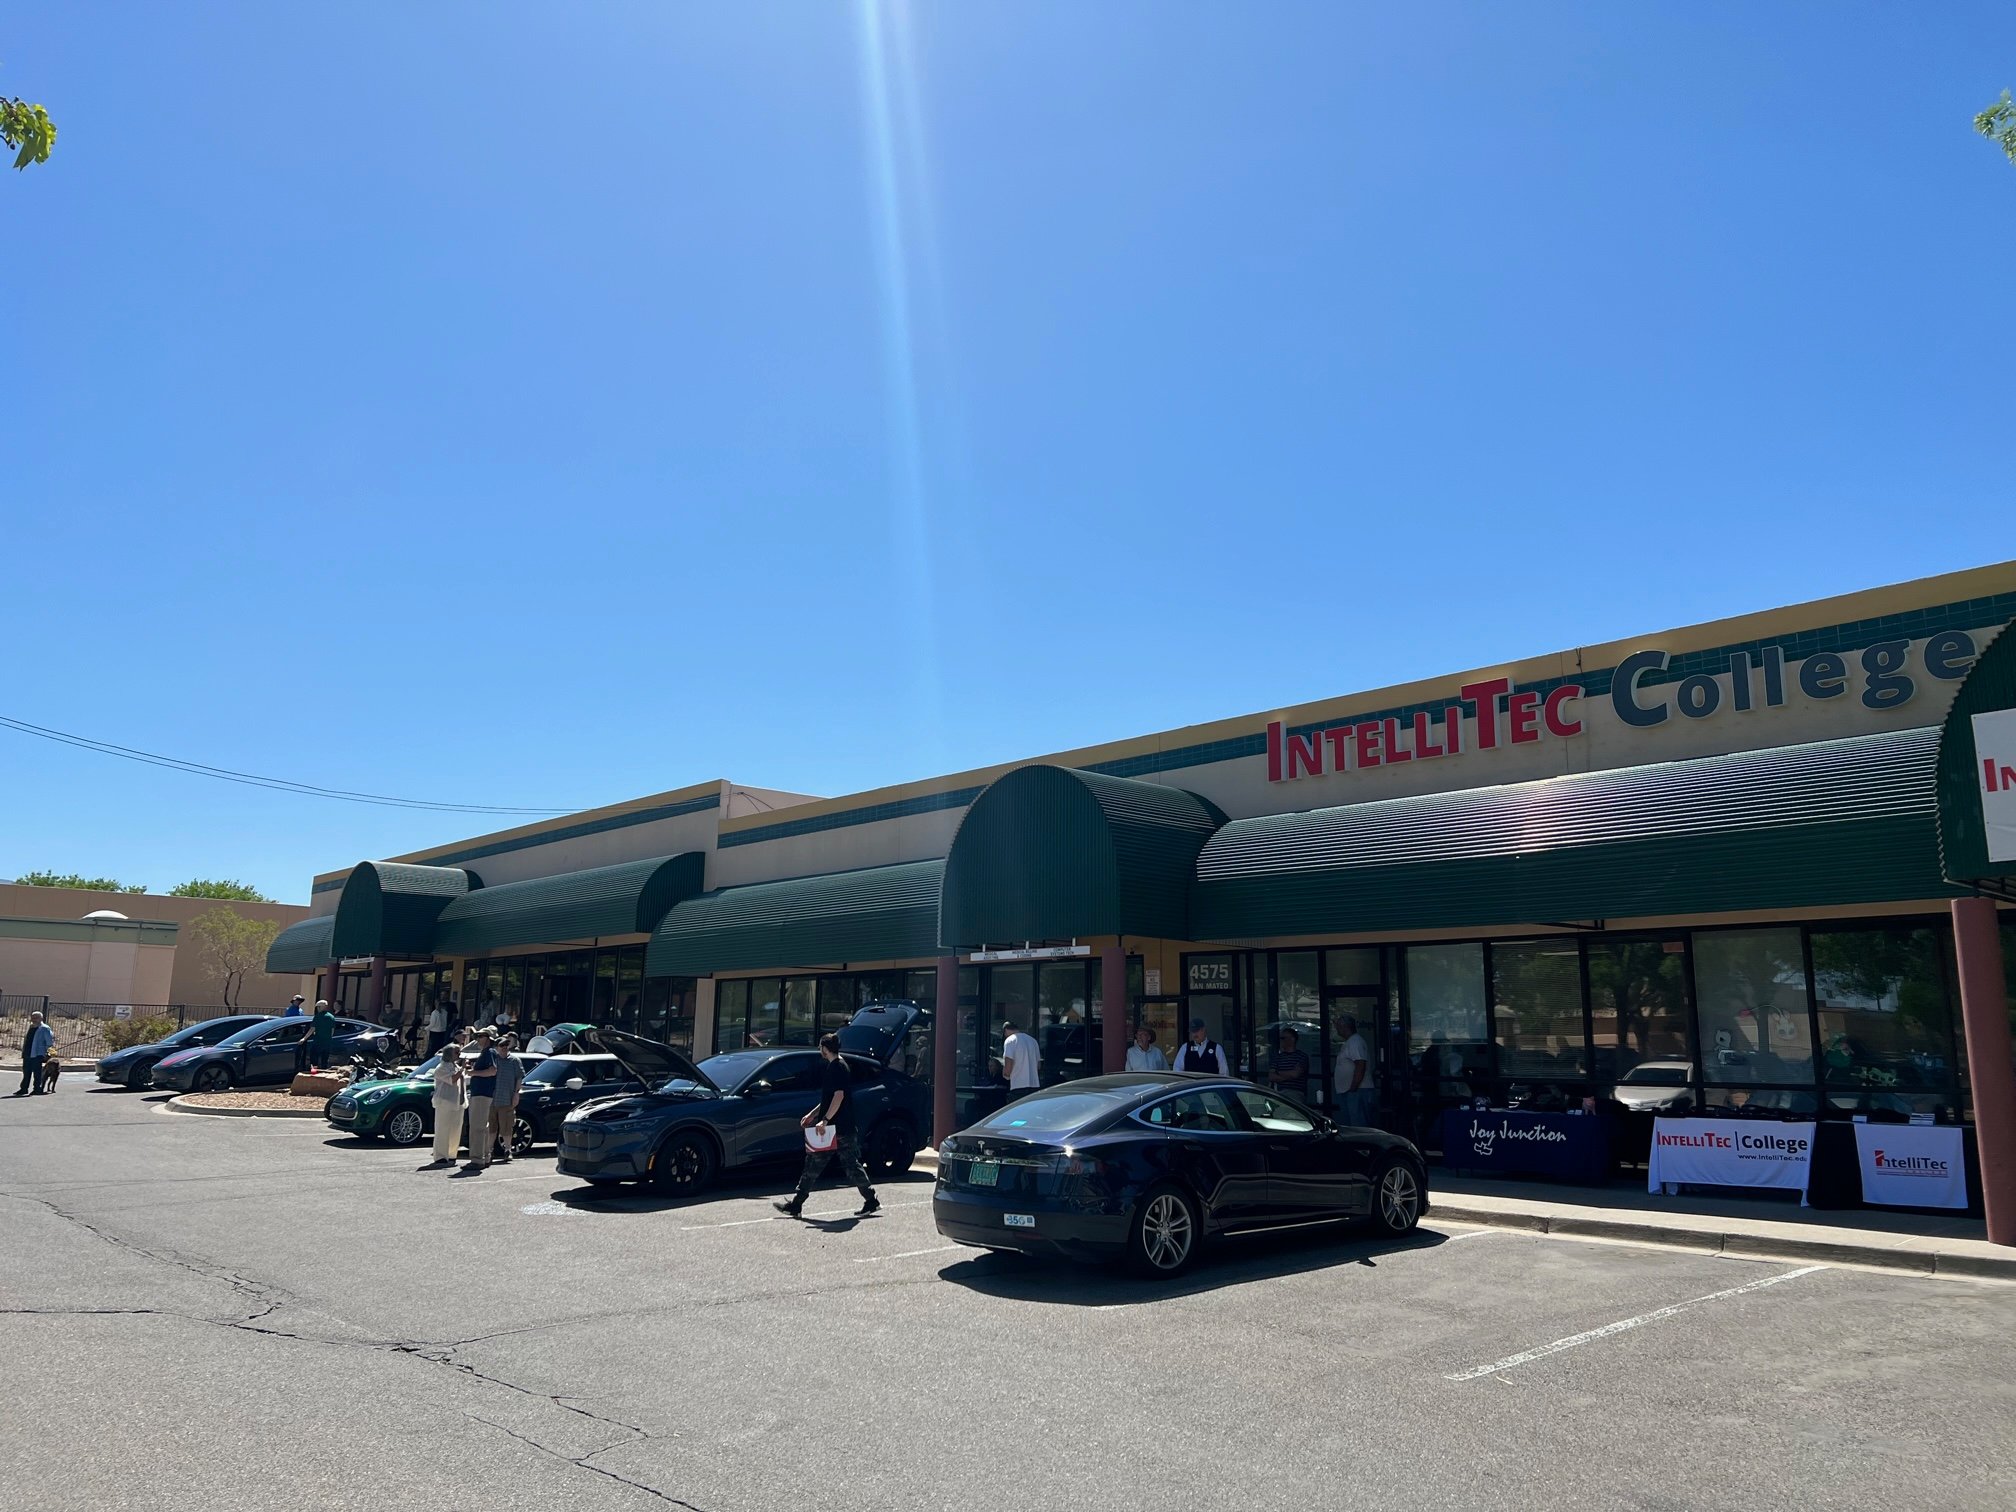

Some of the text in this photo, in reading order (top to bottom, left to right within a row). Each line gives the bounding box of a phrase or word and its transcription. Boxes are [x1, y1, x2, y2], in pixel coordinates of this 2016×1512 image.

[1611, 629, 1978, 729] College
[1189, 964, 1229, 980] 4575
[1205, 982, 1229, 990] MATEO
[1469, 1119, 1567, 1147] Joy Junction
[1741, 1135, 1808, 1154] College
